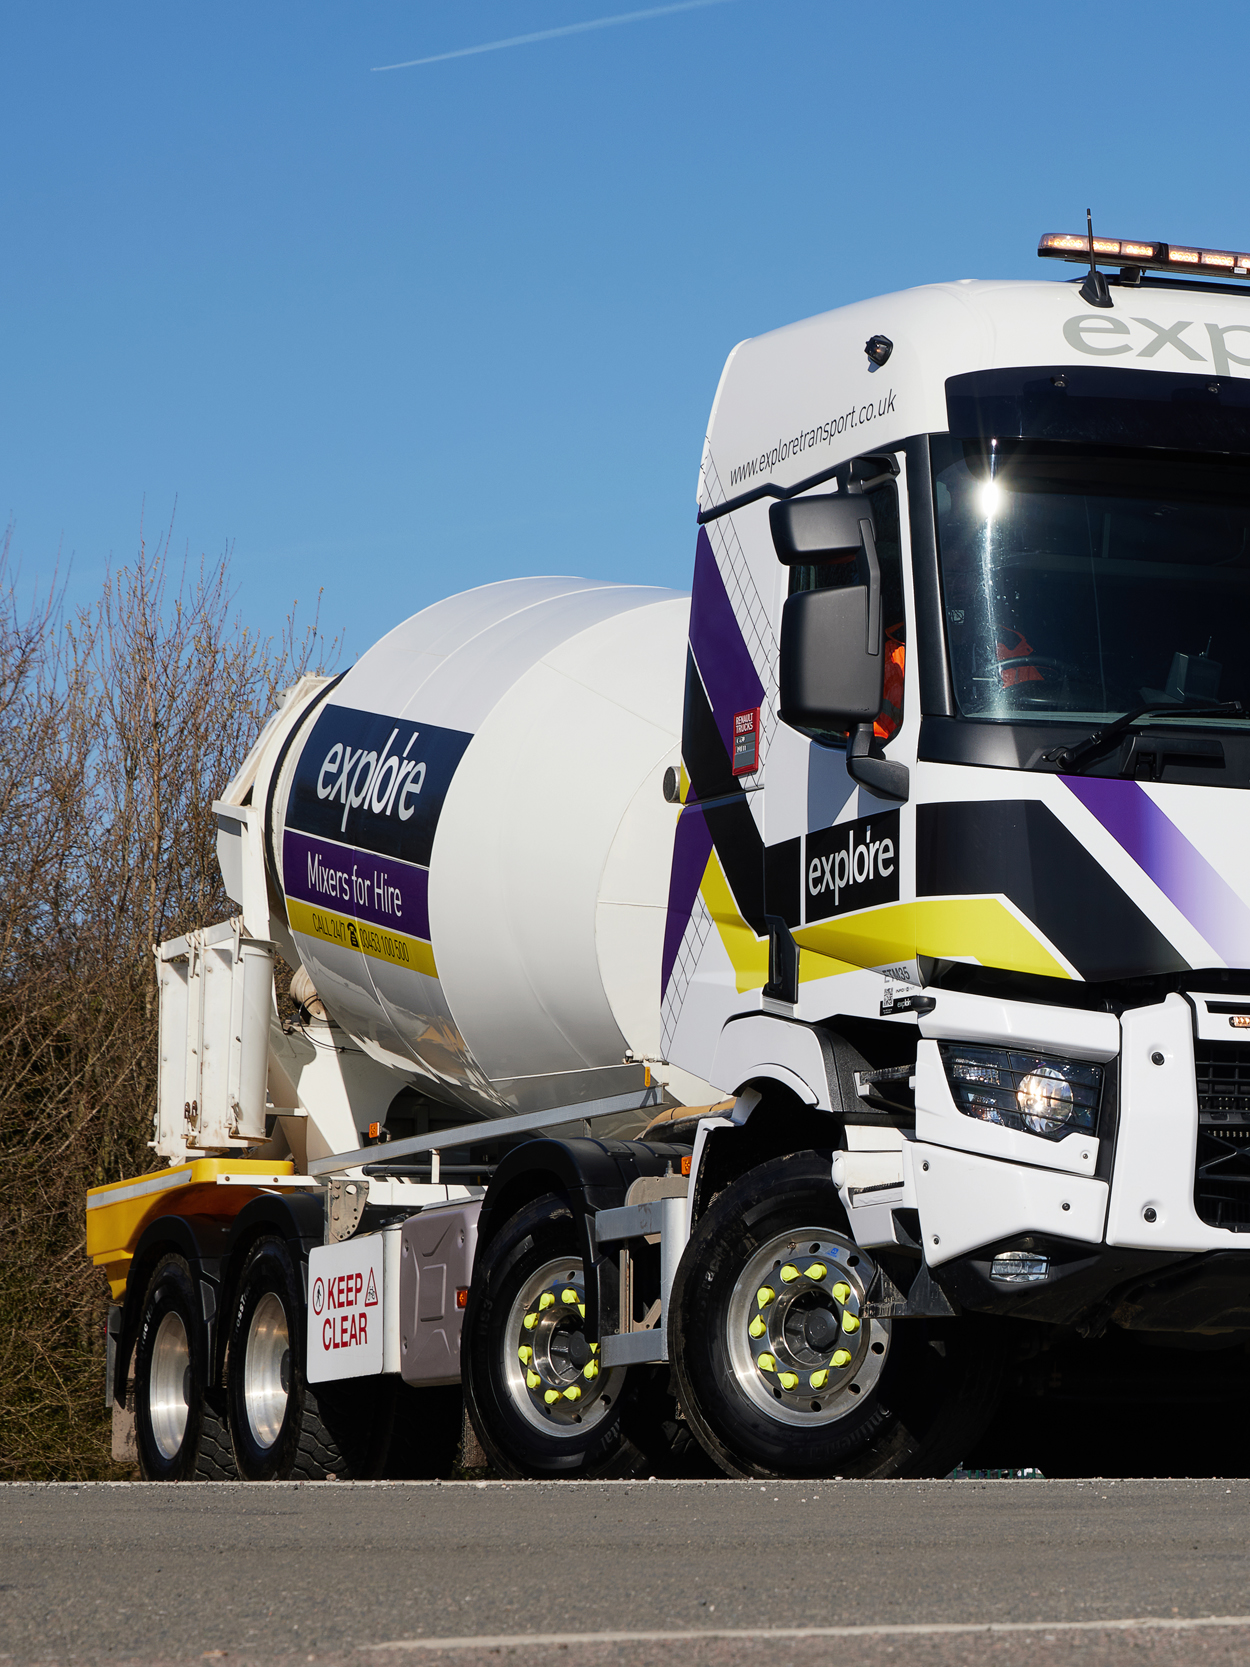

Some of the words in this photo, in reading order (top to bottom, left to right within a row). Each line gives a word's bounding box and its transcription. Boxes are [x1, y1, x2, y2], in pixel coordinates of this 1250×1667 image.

[730, 388, 897, 487] www.exploretransport.co.uk
[735, 712, 754, 725] RENAULT
[735, 721, 754, 734] TRUCKS
[316, 728, 427, 833] explore
[307, 851, 350, 901] Mixers
[351, 864, 371, 907] for
[374, 870, 403, 917] Hire
[808, 825, 895, 906] explore
[312, 913, 333, 937] CALL
[331, 919, 347, 942] 24/7
[359, 927, 381, 953] 03453
[380, 936, 395, 957] 100
[394, 939, 410, 962] 500
[327, 1272, 363, 1310] KEEP
[322, 1312, 368, 1351] CLEAR
